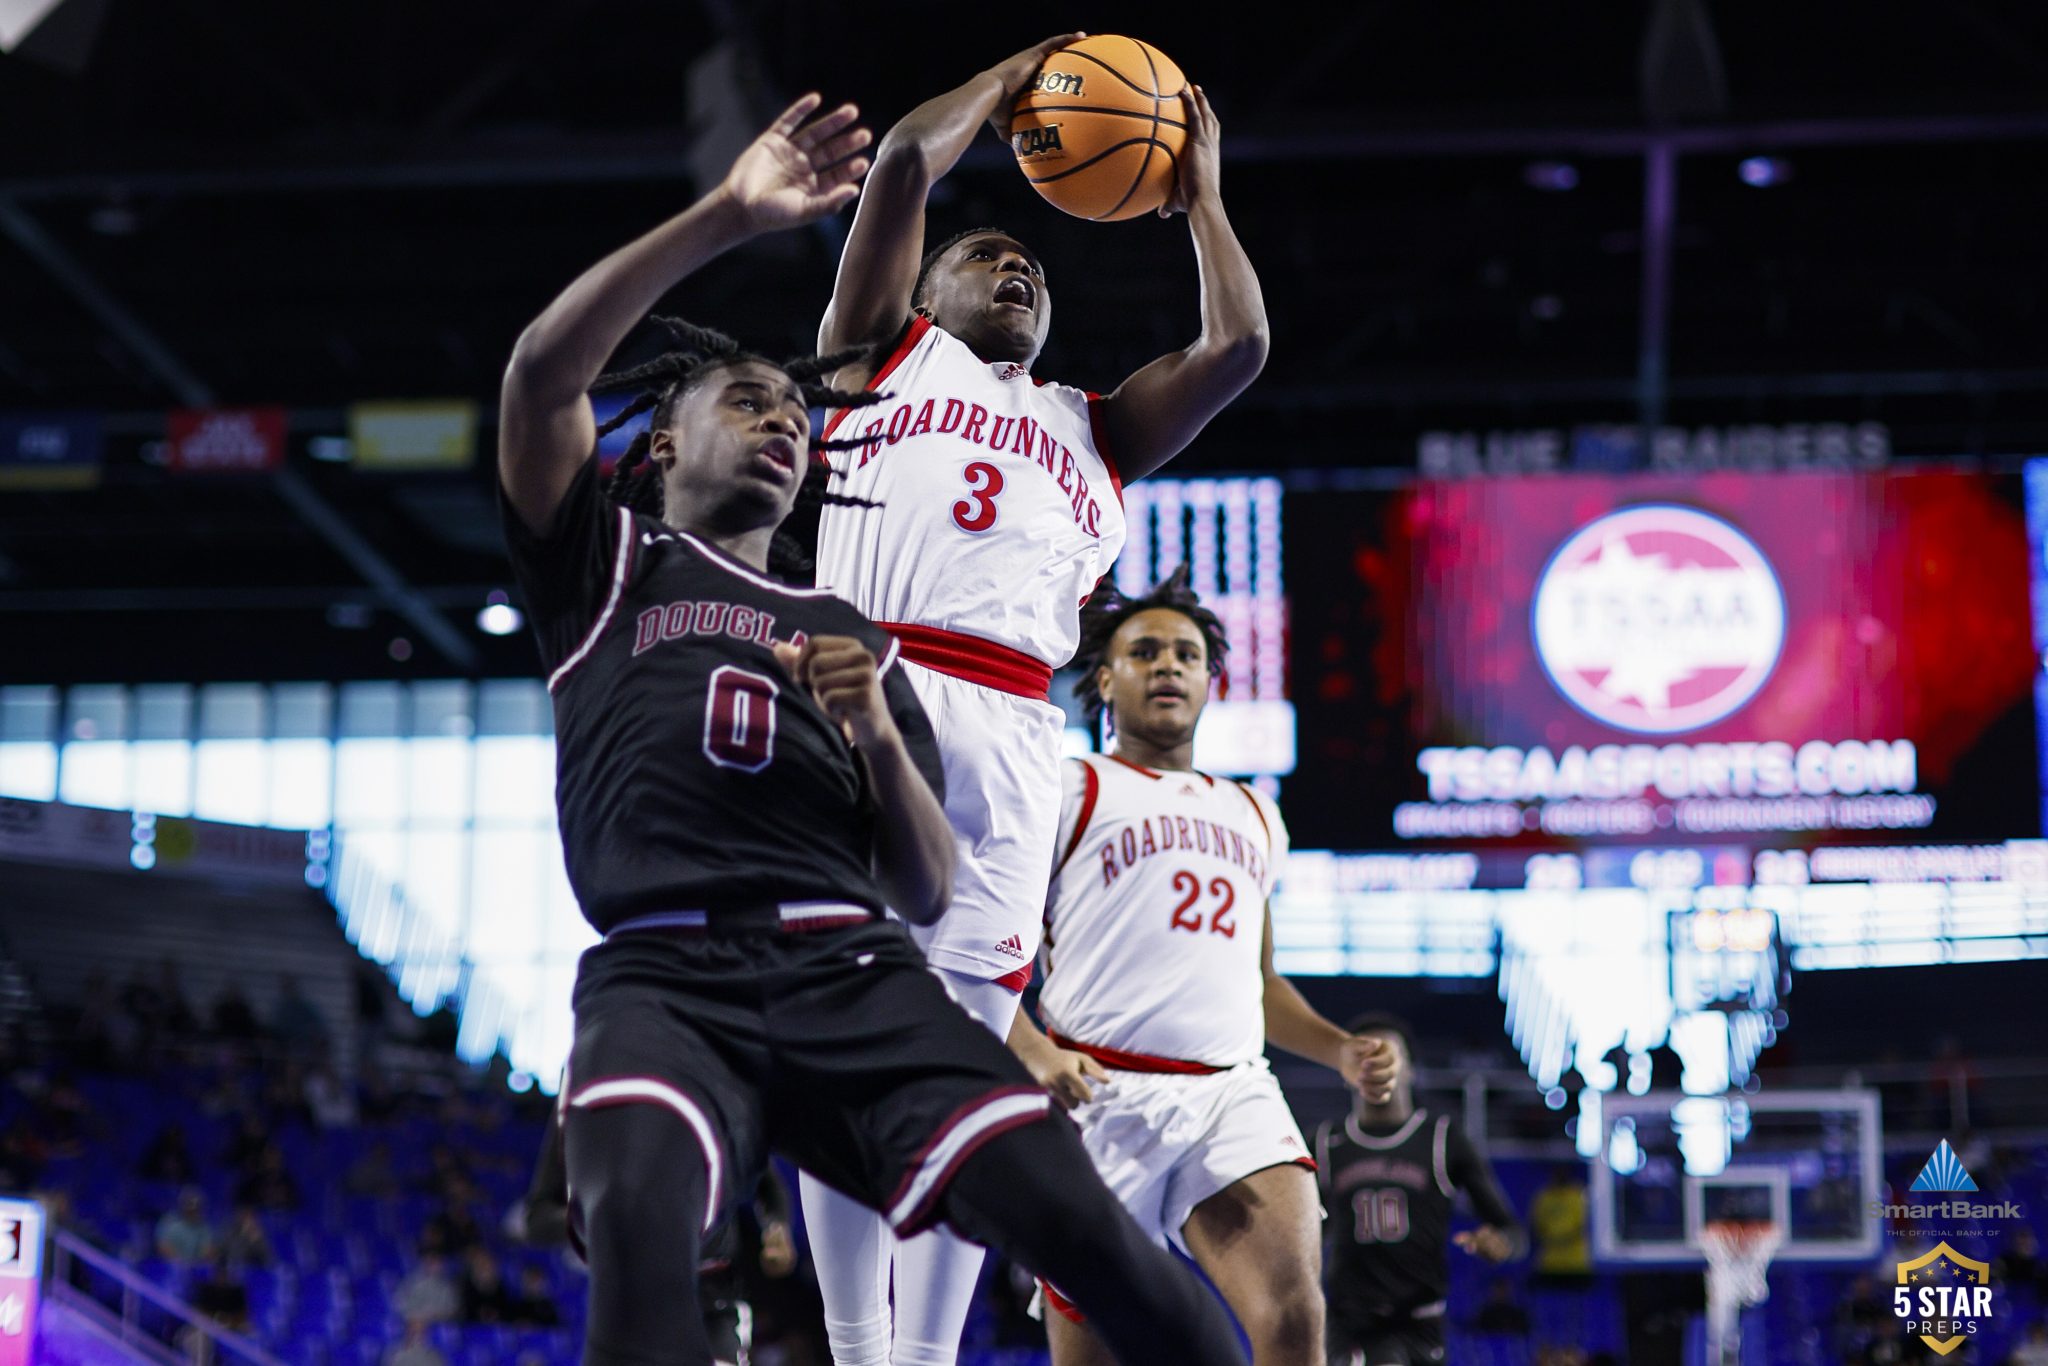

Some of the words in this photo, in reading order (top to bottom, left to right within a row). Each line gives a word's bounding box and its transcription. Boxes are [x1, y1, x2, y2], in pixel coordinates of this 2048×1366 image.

[858, 398, 1100, 539] ROADRUNNERS
[1651, 421, 1891, 472] RAIDERS
[951, 460, 1006, 535] 3
[703, 665, 779, 774] 0
[1418, 740, 1917, 800] TSSAASPORTS.COM
[1170, 870, 1236, 939] 22
[995, 943, 1025, 960] adidas
[1352, 1187, 1409, 1244] 10
